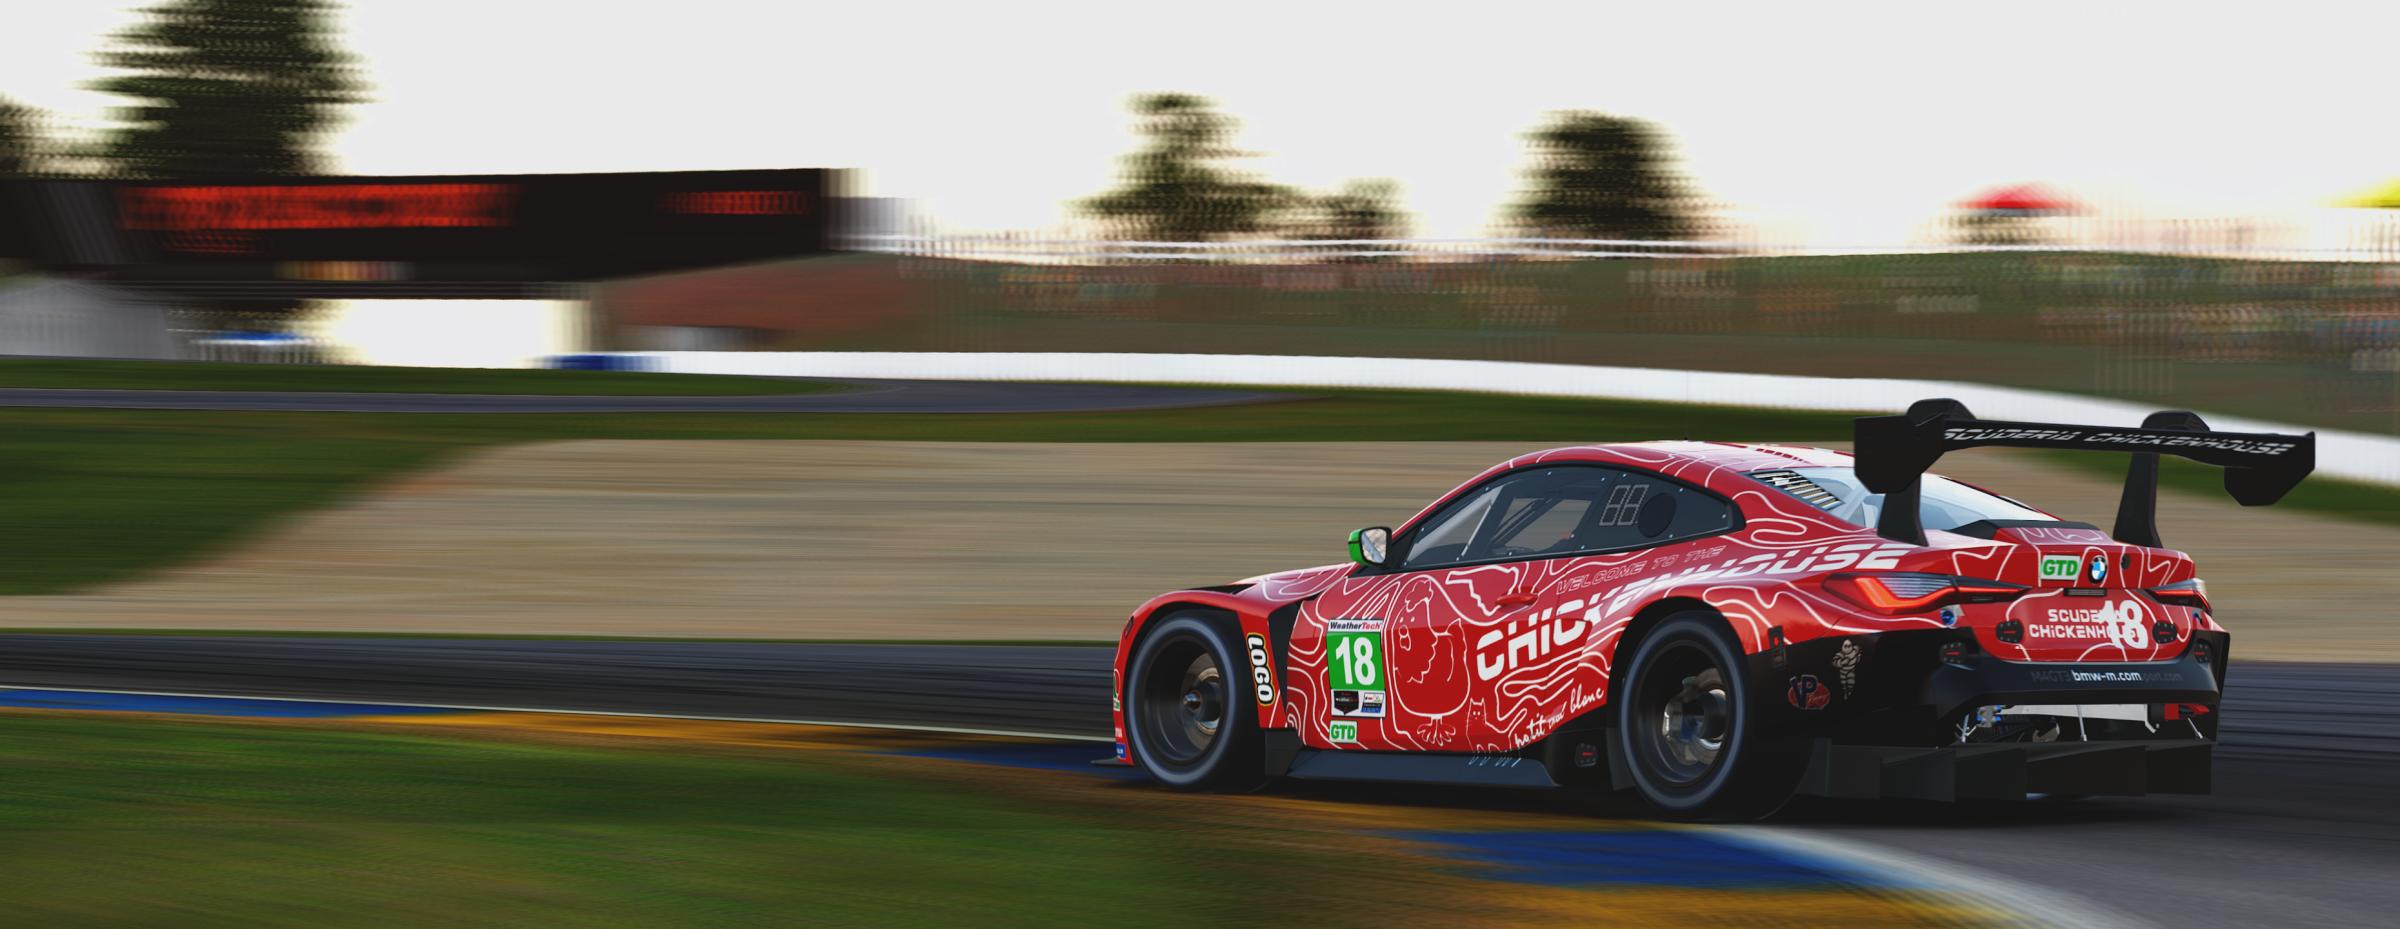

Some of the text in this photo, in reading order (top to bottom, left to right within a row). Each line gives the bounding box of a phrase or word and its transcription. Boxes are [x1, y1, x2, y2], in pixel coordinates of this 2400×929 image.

[1944, 428, 2296, 456] SCUDERIA CHICKENHOUSE
[1556, 544, 1727, 595] WELCOME TO THE
[2042, 559, 2079, 577] GTD
[1329, 621, 1382, 631] WeatherTech
[1476, 544, 1921, 681] CHICKENHOUSE
[2099, 599, 2149, 650] 18
[1246, 634, 1275, 706] LOGO
[1335, 636, 1377, 686] 18
[2072, 669, 2142, 682] bmw-m.com
[1330, 723, 1356, 741] GTD
